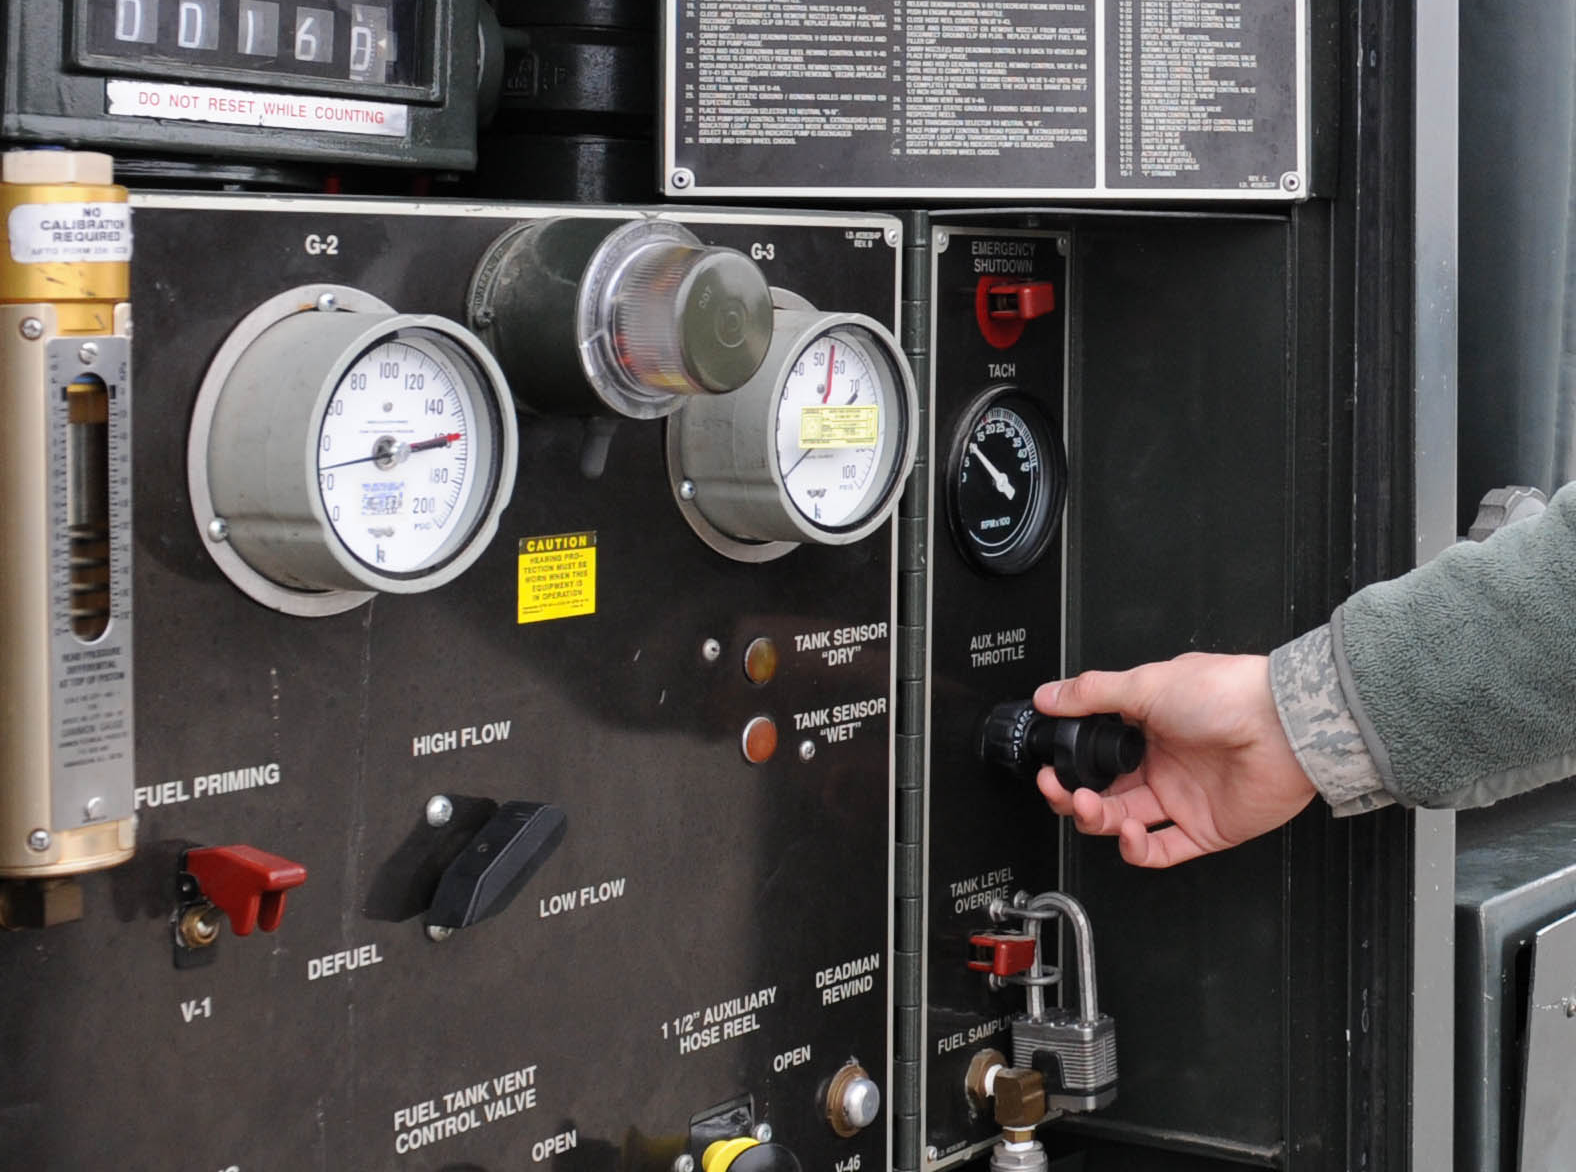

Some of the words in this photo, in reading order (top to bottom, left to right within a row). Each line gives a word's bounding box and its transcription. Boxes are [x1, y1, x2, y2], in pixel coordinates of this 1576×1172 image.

[138, 92, 165, 106] DO
[169, 93, 199, 109] NOT
[208, 97, 255, 114] RESET
[264, 101, 307, 118] WHILE
[315, 105, 385, 124] COUNTING
[83, 207, 101, 217] NO
[53, 231, 120, 242] REQUIRED
[305, 234, 338, 257] G-2
[971, 239, 1036, 257] EMERGENCY
[750, 243, 776, 261] G-3
[973, 257, 1033, 274] SHUTDOWN
[379, 362, 400, 379] 100
[813, 352, 825, 367] 50
[988, 362, 1016, 378] TACH
[351, 373, 367, 390] 80
[404, 373, 424, 390] 120
[424, 399, 444, 415] 140
[986, 424, 996, 435] 20
[996, 423, 1005, 433] 25
[842, 465, 856, 479] 100
[412, 497, 435, 514] 200
[527, 535, 587, 552] CAUTION
[794, 630, 831, 652] TANK
[834, 622, 888, 646] SENSOR
[970, 632, 995, 652] AUX.
[997, 628, 1026, 647] HAND
[971, 645, 1025, 668] THROTTLE
[793, 709, 829, 731] TANK
[833, 698, 887, 722] SENSOR
[412, 730, 457, 757] HIGH
[460, 721, 511, 747] FLOW
[134, 780, 188, 810] FUEL
[194, 763, 281, 800] PRIMING
[950, 878, 979, 899] TANK
[982, 867, 1014, 888] LEVEL
[539, 890, 577, 918] LOW
[580, 878, 626, 906] FLOW
[955, 884, 1010, 914] OVERRIDE
[307, 944, 383, 980] DEFUEL
[815, 953, 880, 989] DEADMAN
[822, 975, 874, 1006] REWIND
[180, 996, 213, 1023] V-1
[661, 1022, 669, 1040] 1
[704, 986, 777, 1026] AUXILIARY
[679, 1027, 720, 1055] HOSE
[723, 1016, 760, 1045] REEL
[938, 1032, 966, 1055] FUEL
[773, 1044, 811, 1072] OPEN
[394, 1105, 440, 1132] FUEL
[443, 1085, 490, 1118] TANK
[492, 1066, 537, 1100] VENT
[396, 1117, 481, 1155] CONTROL
[483, 1088, 537, 1122] VALVE
[531, 1130, 577, 1163] OPEN
[835, 1154, 861, 1172] V-46
